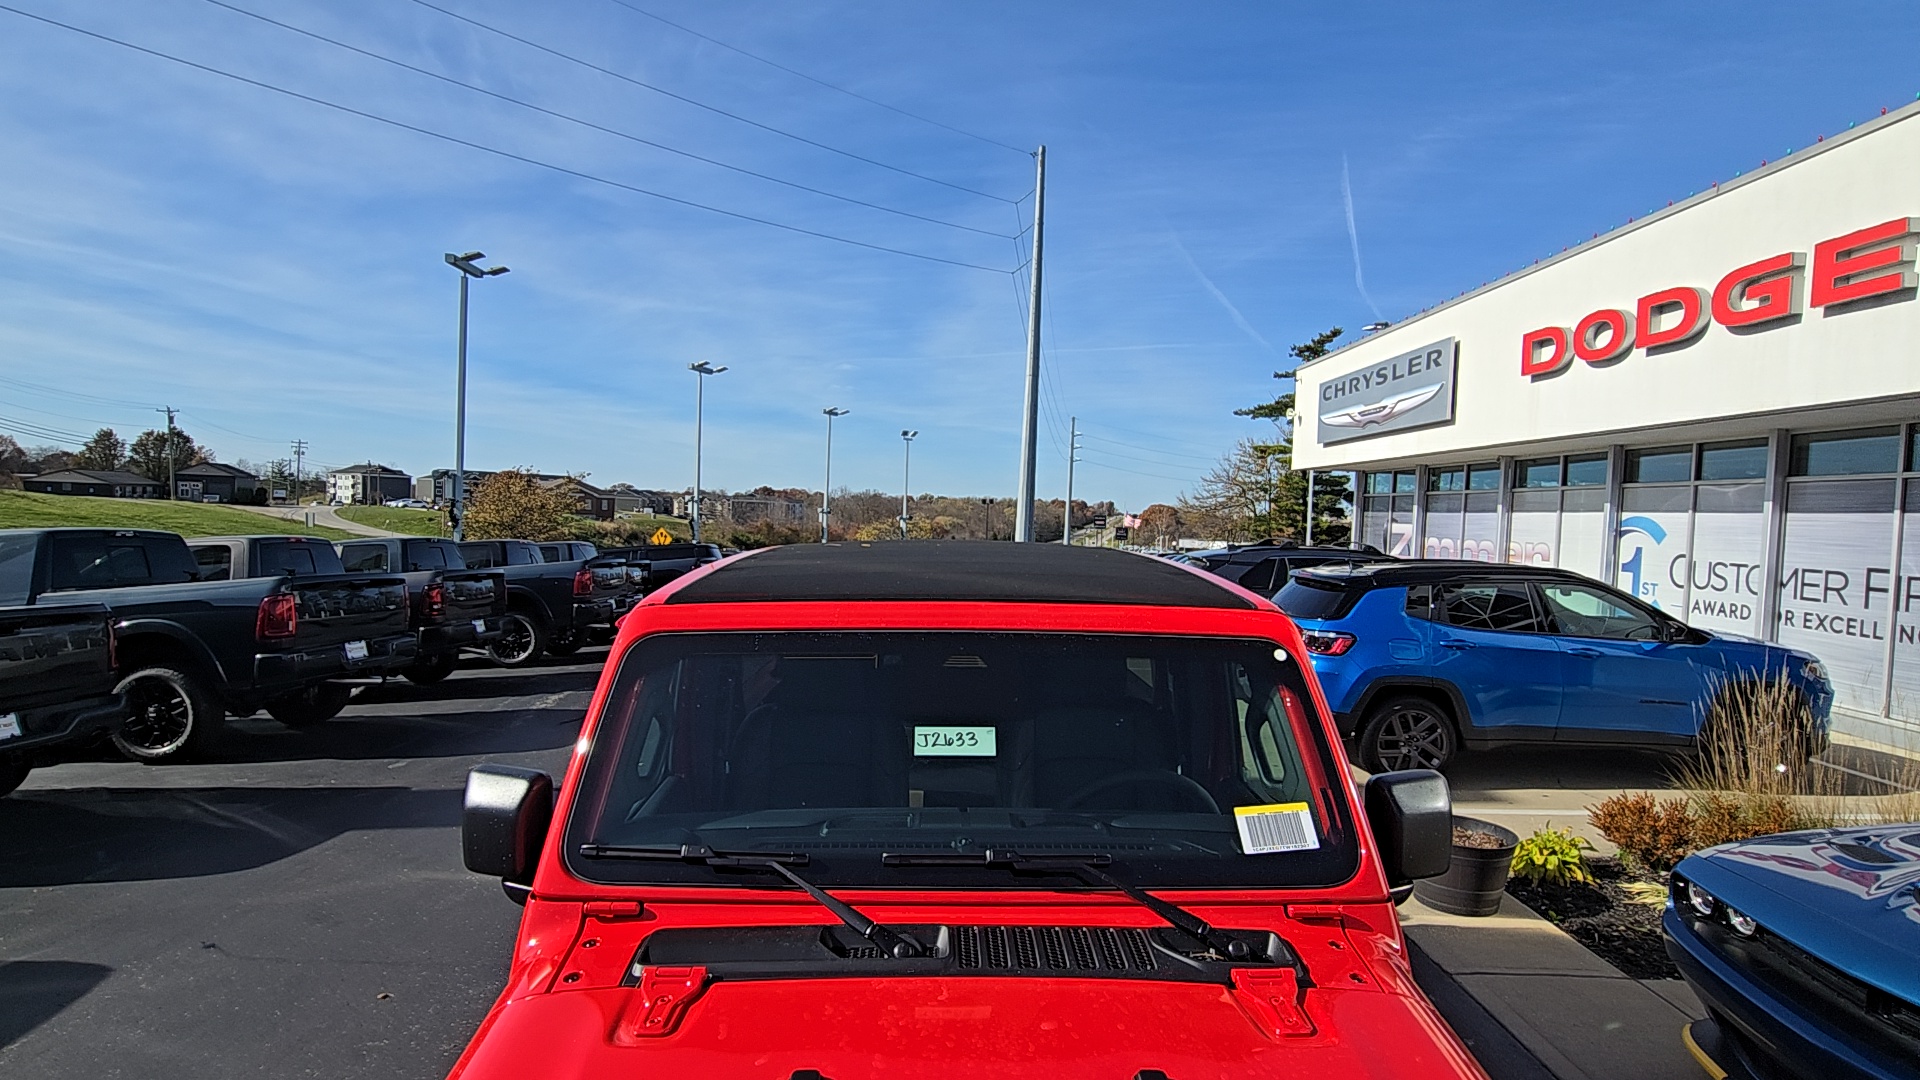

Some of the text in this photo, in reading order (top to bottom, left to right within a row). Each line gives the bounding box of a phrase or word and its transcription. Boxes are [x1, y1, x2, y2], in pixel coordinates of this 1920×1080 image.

[1521, 217, 1917, 377] DODGE
[1323, 349, 1443, 401] CHRYSLER
[1391, 523, 1551, 563] Zmmer
[1691, 599, 1751, 620] AWARD
[917, 731, 979, 748] J2633
